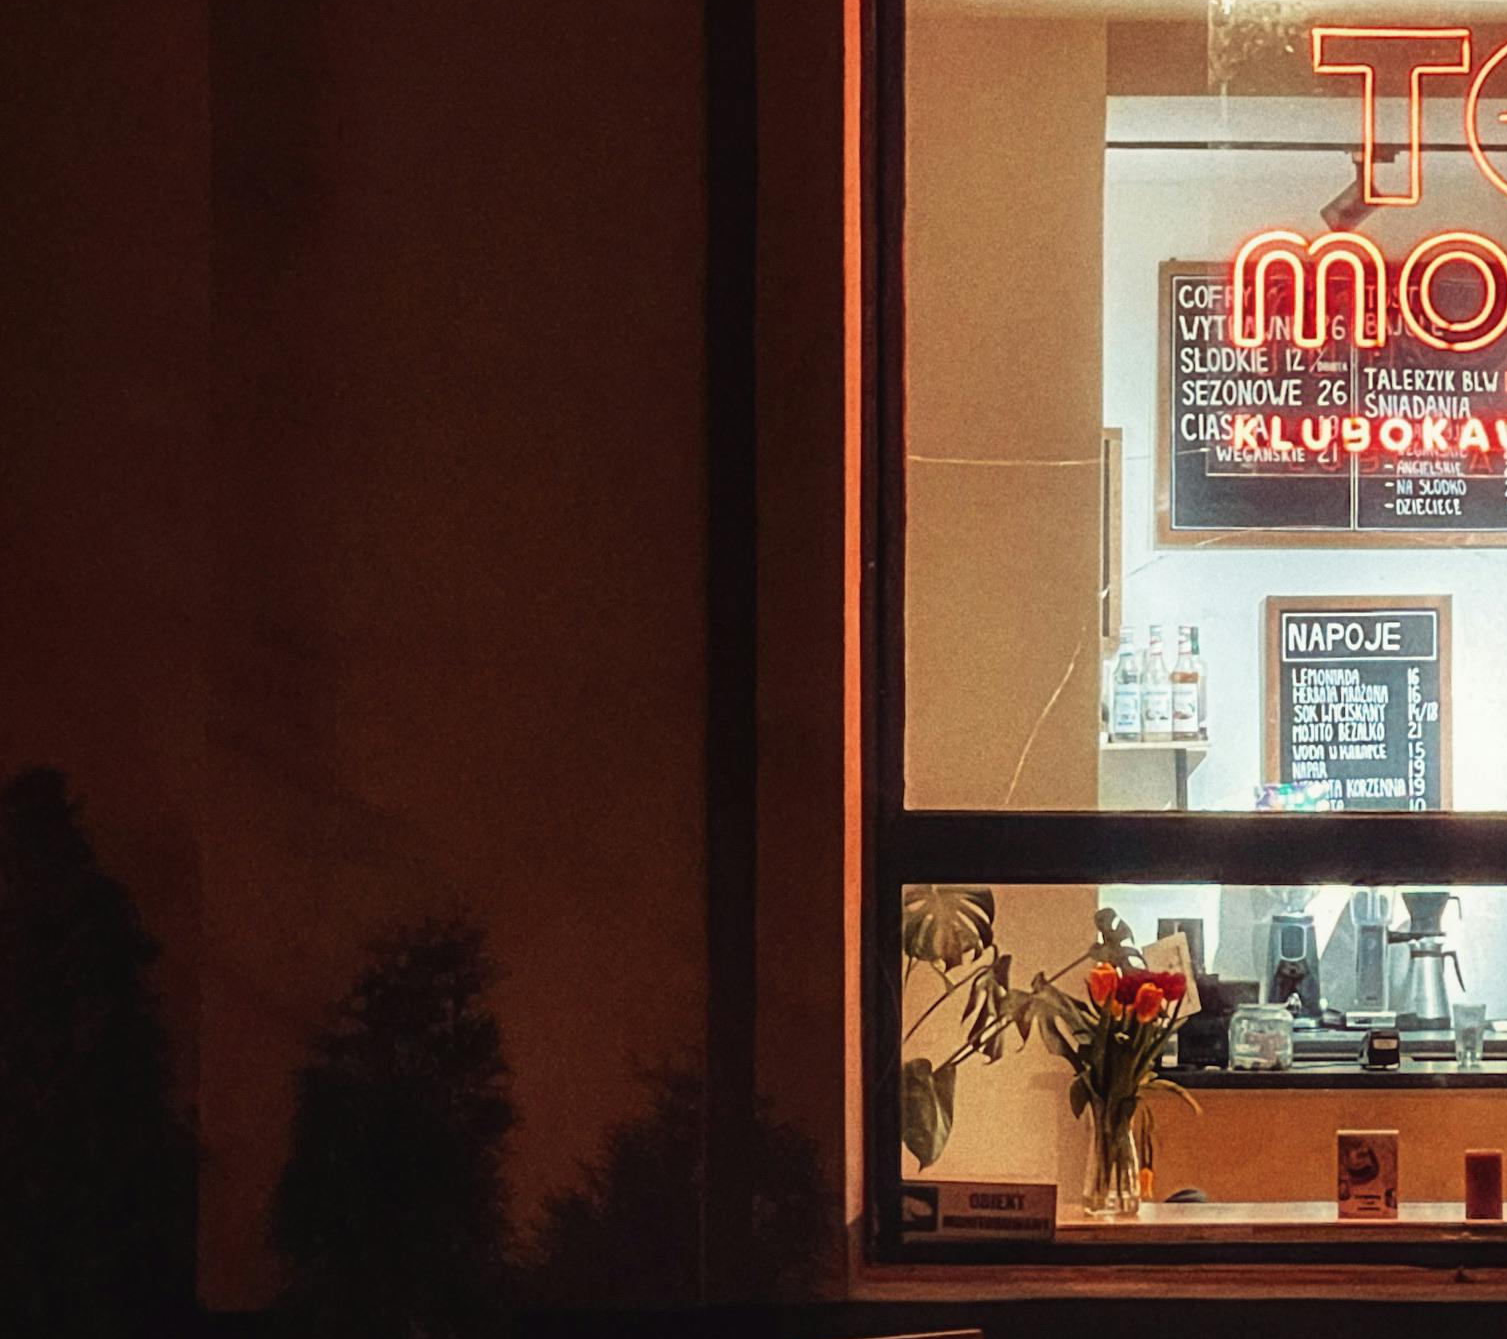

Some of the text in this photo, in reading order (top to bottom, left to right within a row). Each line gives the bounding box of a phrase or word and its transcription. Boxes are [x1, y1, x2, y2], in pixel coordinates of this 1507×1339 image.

[1286, 348, 1306, 372] 12
[1364, 367, 1455, 392] TALERZYK
[1462, 370, 1499, 392] BLW
[1182, 379, 1348, 406] SEZONOWE 26
[1364, 390, 1472, 419] ŚNIADANIA
[1180, 413, 1269, 441] CIASA
[1288, 622, 1402, 652] NAPOJE
[1292, 667, 1420, 686] LEMONIADA 16
[1293, 704, 1319, 723] SOK
[1292, 723, 1334, 743] MOJITO
[1407, 722, 1422, 739] 21
[1408, 741, 1426, 759] 15
[1408, 759, 1426, 778] 19
[1408, 778, 1426, 797] 19
